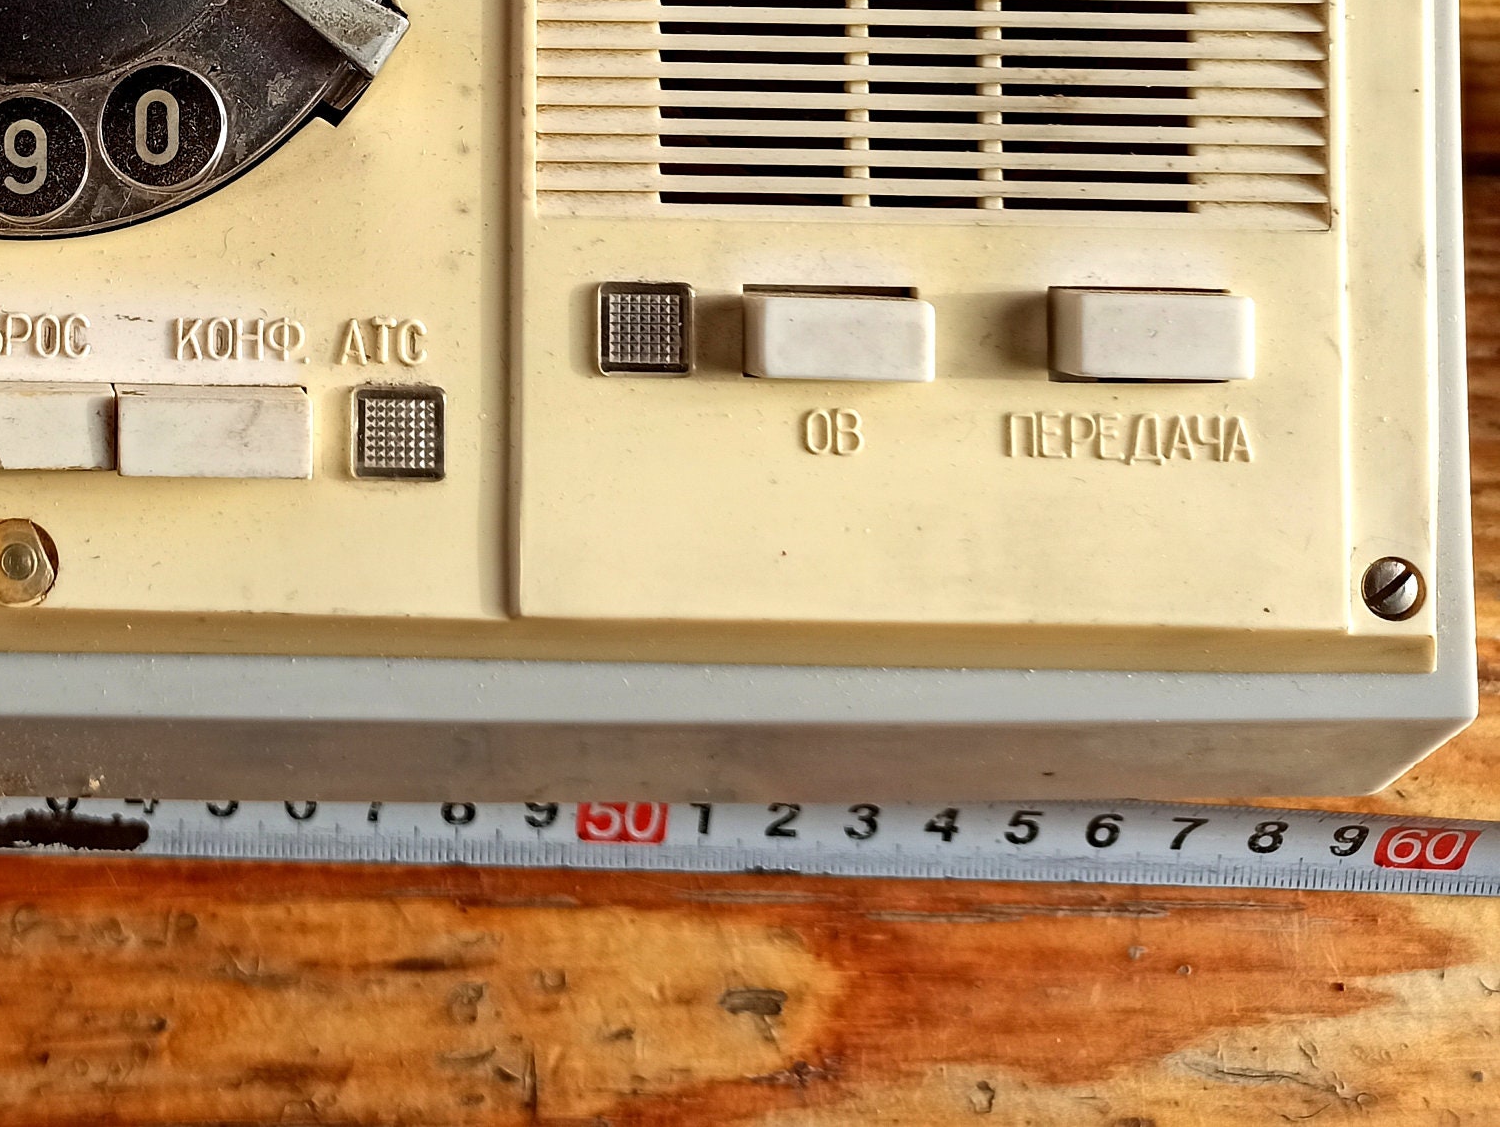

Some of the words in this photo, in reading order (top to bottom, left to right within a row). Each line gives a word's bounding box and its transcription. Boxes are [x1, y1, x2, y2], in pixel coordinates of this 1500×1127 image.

[3, 118, 48, 196] 9
[135, 89, 180, 167] 0
[174, 316, 311, 367] КОНФ.
[337, 316, 430, 367] АТС
[804, 407, 864, 456] ОВ
[1005, 410, 1255, 466] ПЕРЕДАЧА
[586, 802, 663, 840] 50
[690, 802, 711, 834] 1
[764, 803, 801, 837] 2
[843, 803, 880, 840] 3
[924, 807, 960, 842] 4
[1003, 811, 1043, 845] 5
[1085, 813, 1124, 848] 6
[1172, 817, 1208, 851] 7
[1246, 821, 1289, 854] 8
[1329, 825, 1369, 857] 9
[1386, 829, 1467, 864] 60
